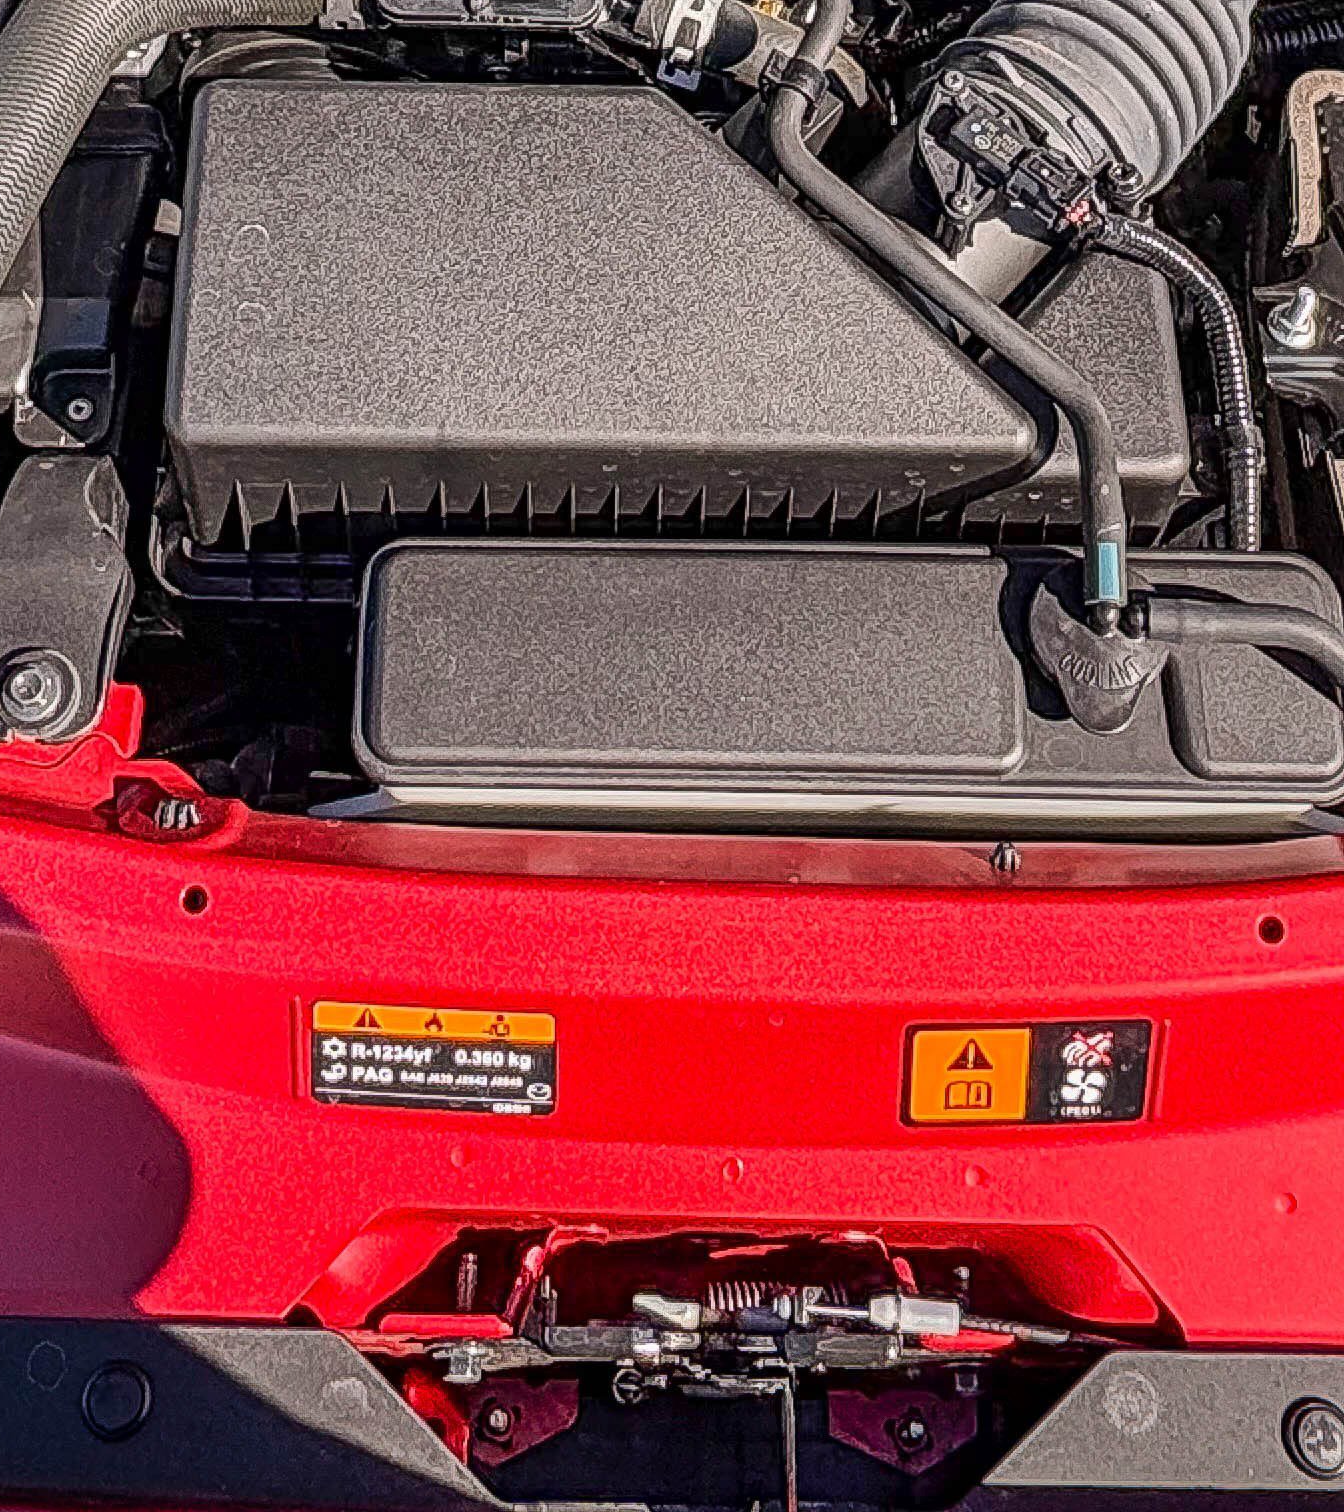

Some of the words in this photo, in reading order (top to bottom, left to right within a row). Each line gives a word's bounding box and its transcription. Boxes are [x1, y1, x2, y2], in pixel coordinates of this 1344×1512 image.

[1059, 651, 1143, 688] COOLANT
[508, 1052, 532, 1072] kg
[352, 1066, 394, 1084] PAG
